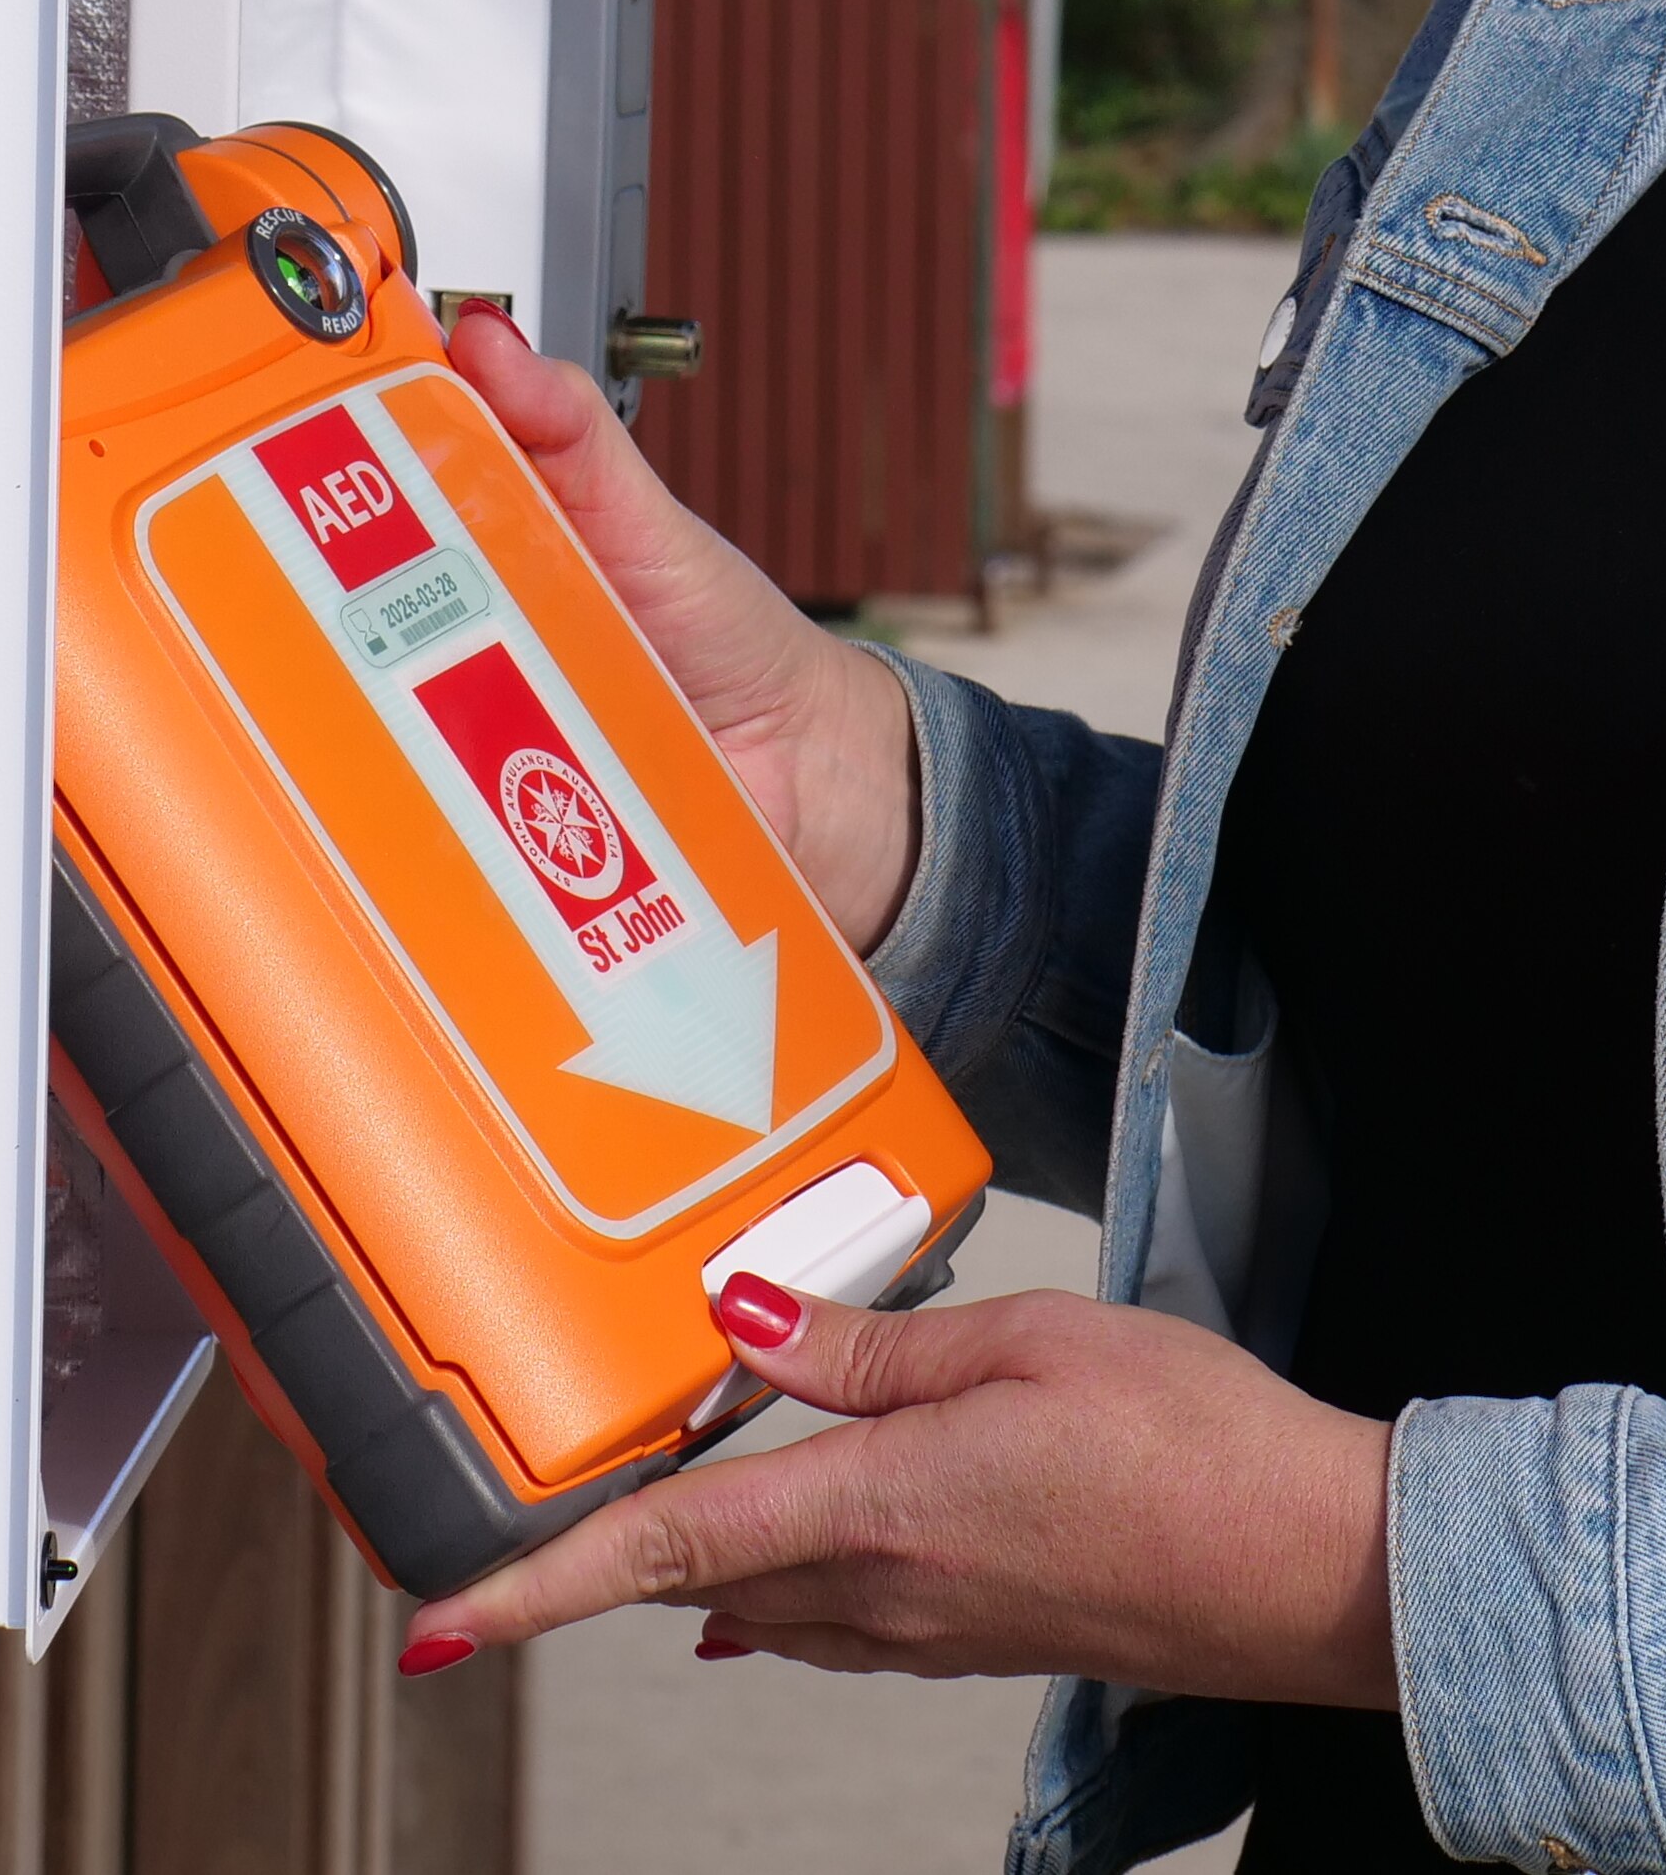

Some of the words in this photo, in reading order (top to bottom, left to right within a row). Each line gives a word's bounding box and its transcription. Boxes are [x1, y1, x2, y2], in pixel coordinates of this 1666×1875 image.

[256, 209, 306, 240] RESCUE
[322, 302, 362, 334] READY
[299, 461, 394, 545] AED
[380, 572, 458, 628] 2026-03-28
[505, 755, 554, 810] AMBULANCE
[562, 768, 618, 858] AUSTRALIA
[513, 821, 546, 865] JOHN
[554, 871, 571, 887] ST
[577, 925, 623, 973] St
[614, 893, 686, 954] John
